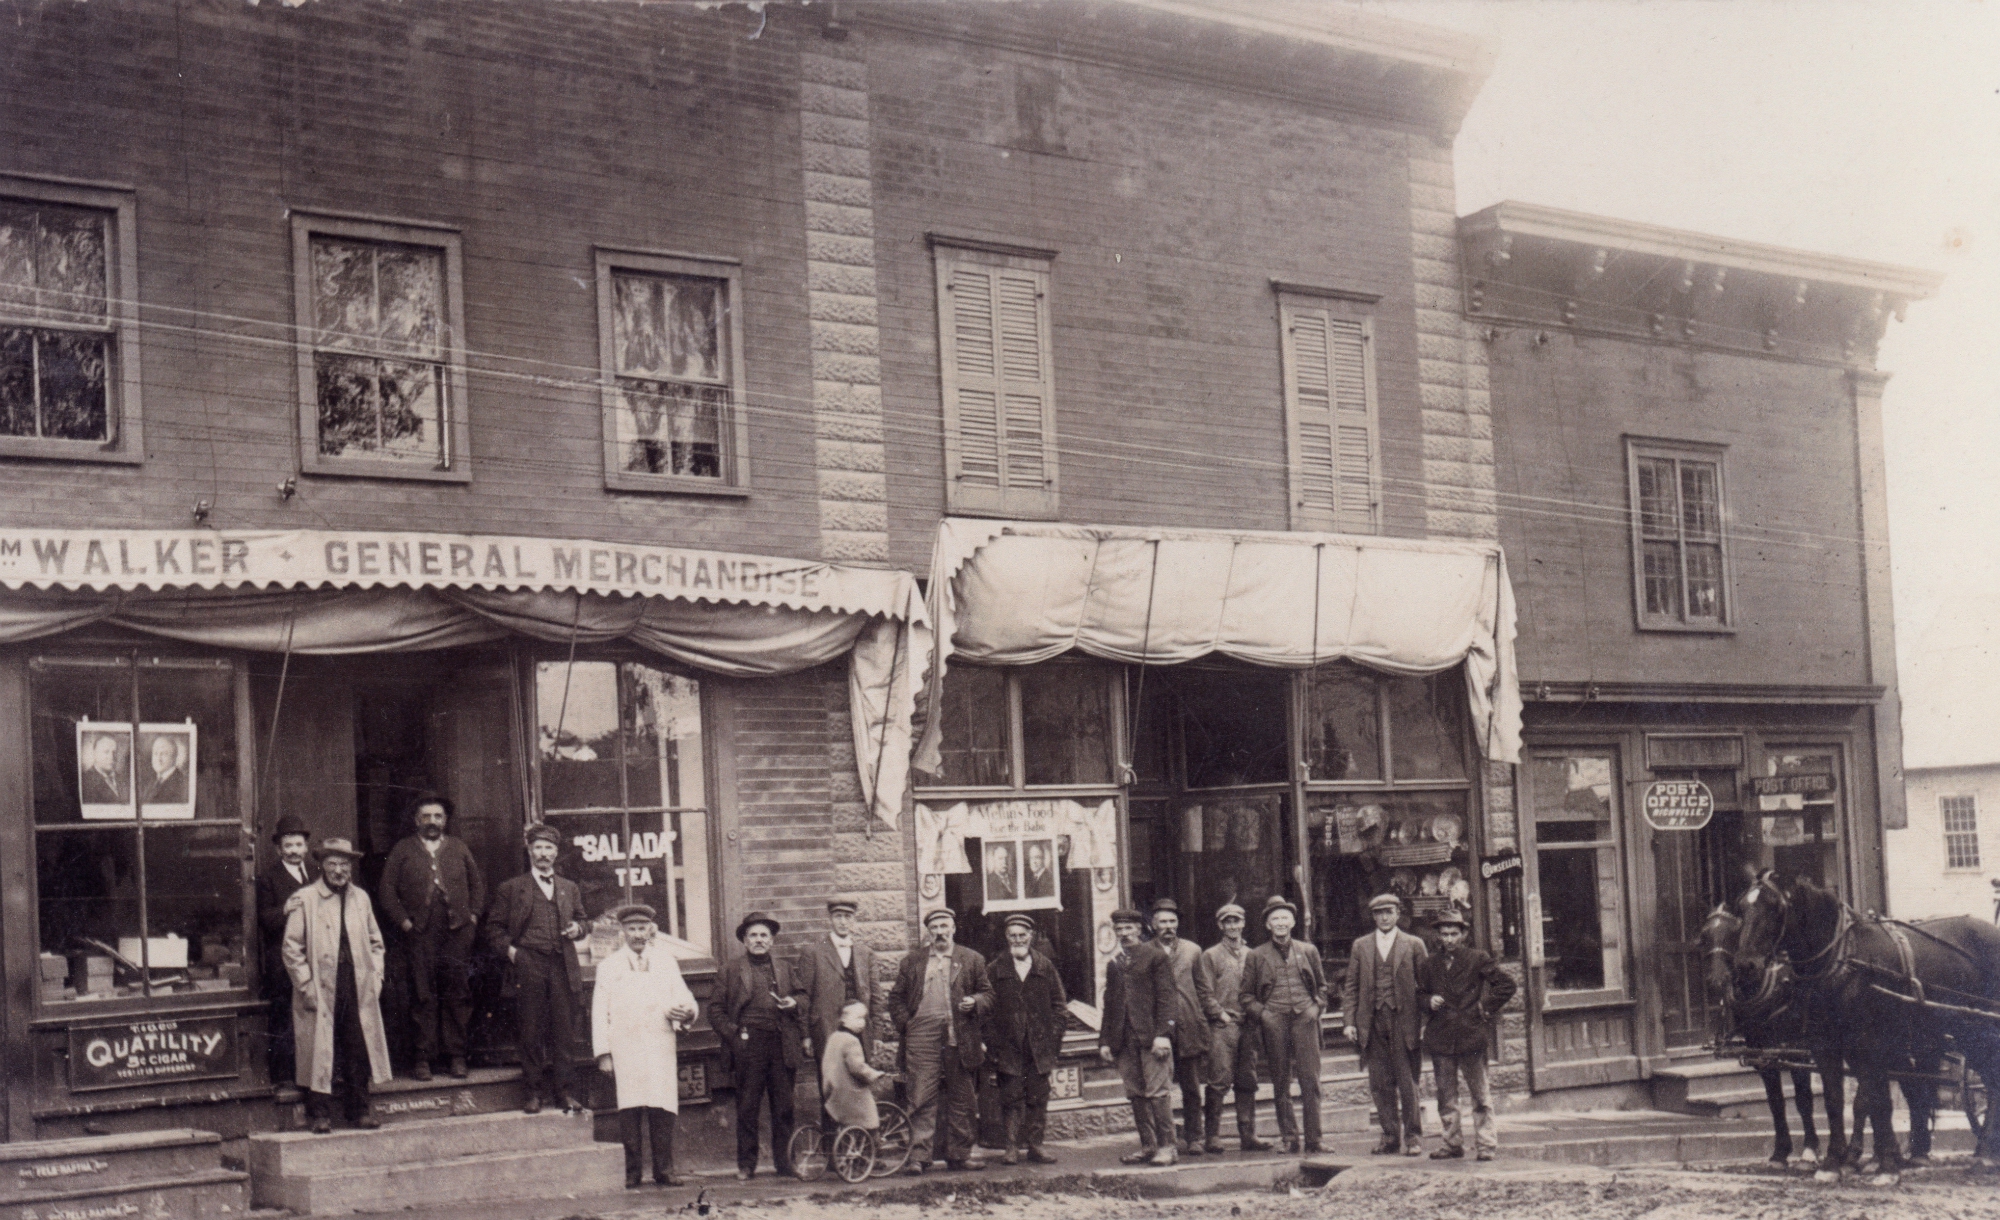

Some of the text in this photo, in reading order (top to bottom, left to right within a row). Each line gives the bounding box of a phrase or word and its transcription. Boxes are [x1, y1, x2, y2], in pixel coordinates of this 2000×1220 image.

[31, 538, 249, 575] WALKER
[324, 540, 536, 578] GENERAL
[553, 547, 819, 597] MERCHANDISE
[1656, 784, 1699, 796] POST
[1755, 778, 1786, 793] POST
[1648, 795, 1709, 807] OFFICE
[615, 867, 653, 887] TEA
[86, 1032, 222, 1067] QUATILITY
[149, 1052, 187, 1066] CIGAR
